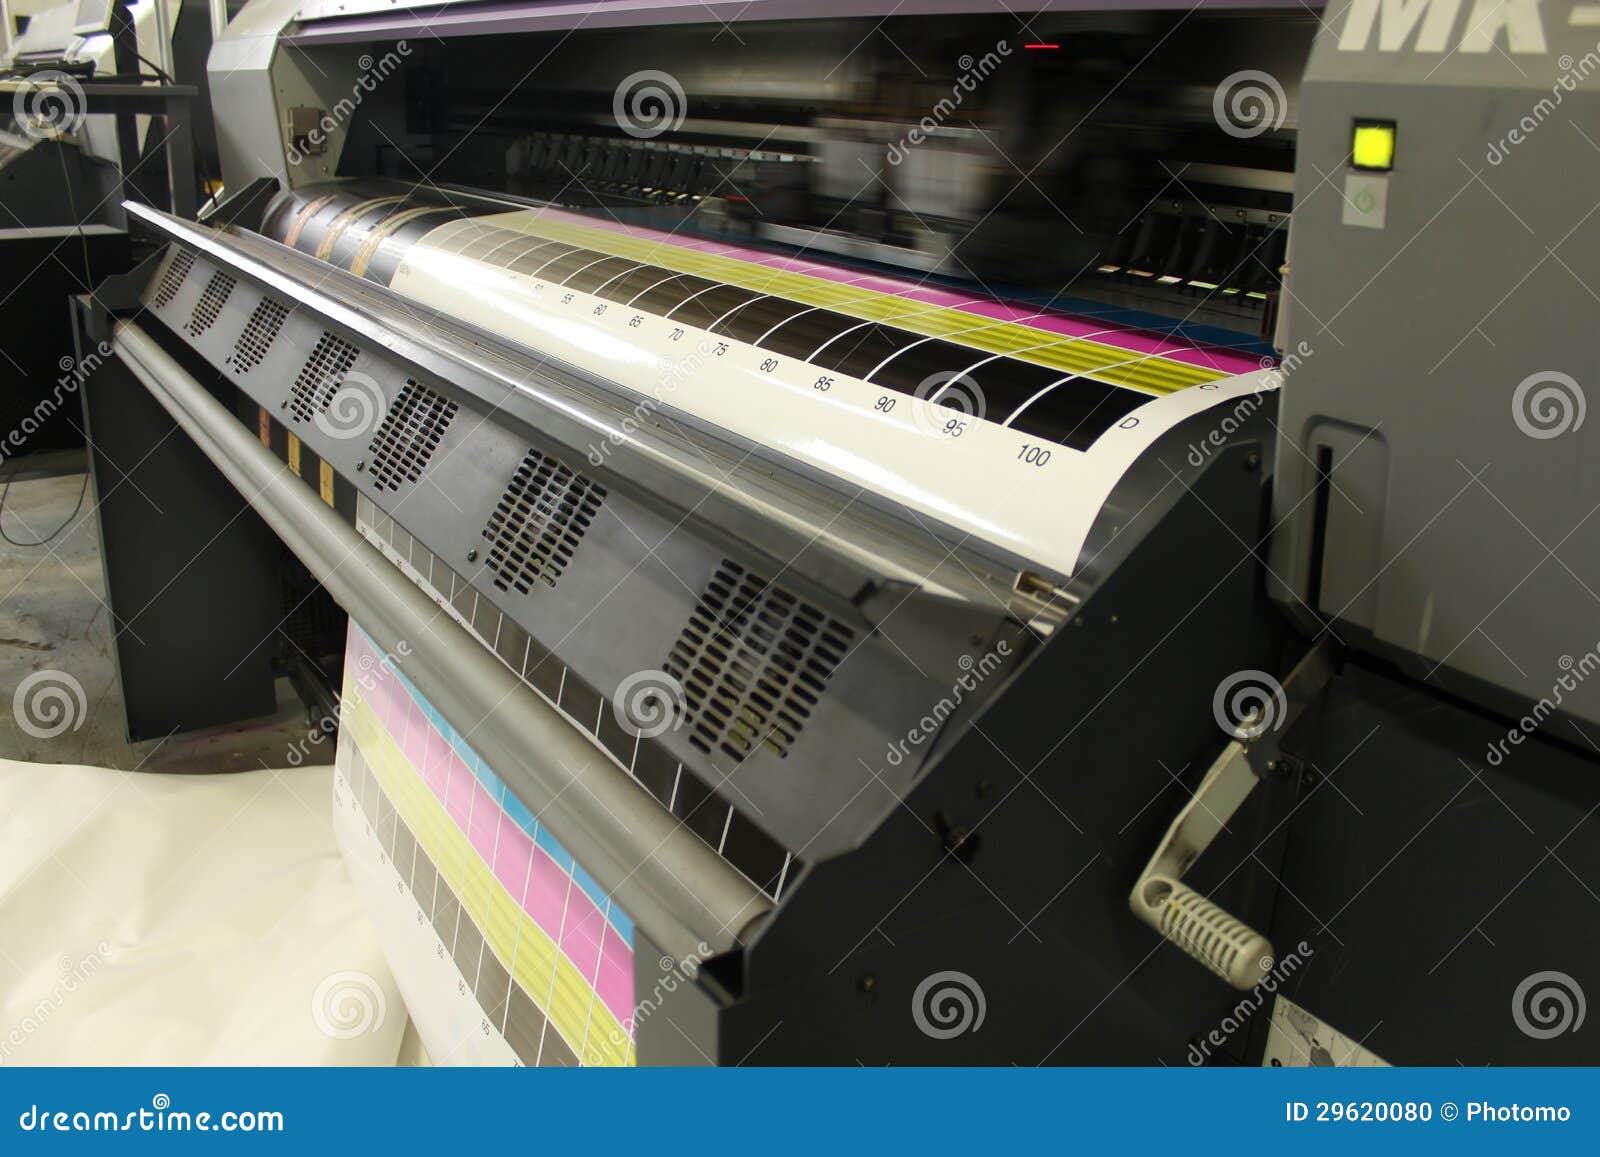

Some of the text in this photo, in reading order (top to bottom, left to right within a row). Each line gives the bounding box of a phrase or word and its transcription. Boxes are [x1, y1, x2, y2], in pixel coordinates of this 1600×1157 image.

[628, 316, 644, 328] 65
[667, 327, 685, 342] 70
[711, 342, 730, 357] 75
[759, 358, 779, 373] 80
[813, 376, 835, 392] 85
[874, 396, 897, 413] 90
[943, 419, 967, 438] 95
[1017, 444, 1052, 467] 100
[1119, 417, 1140, 429] D
